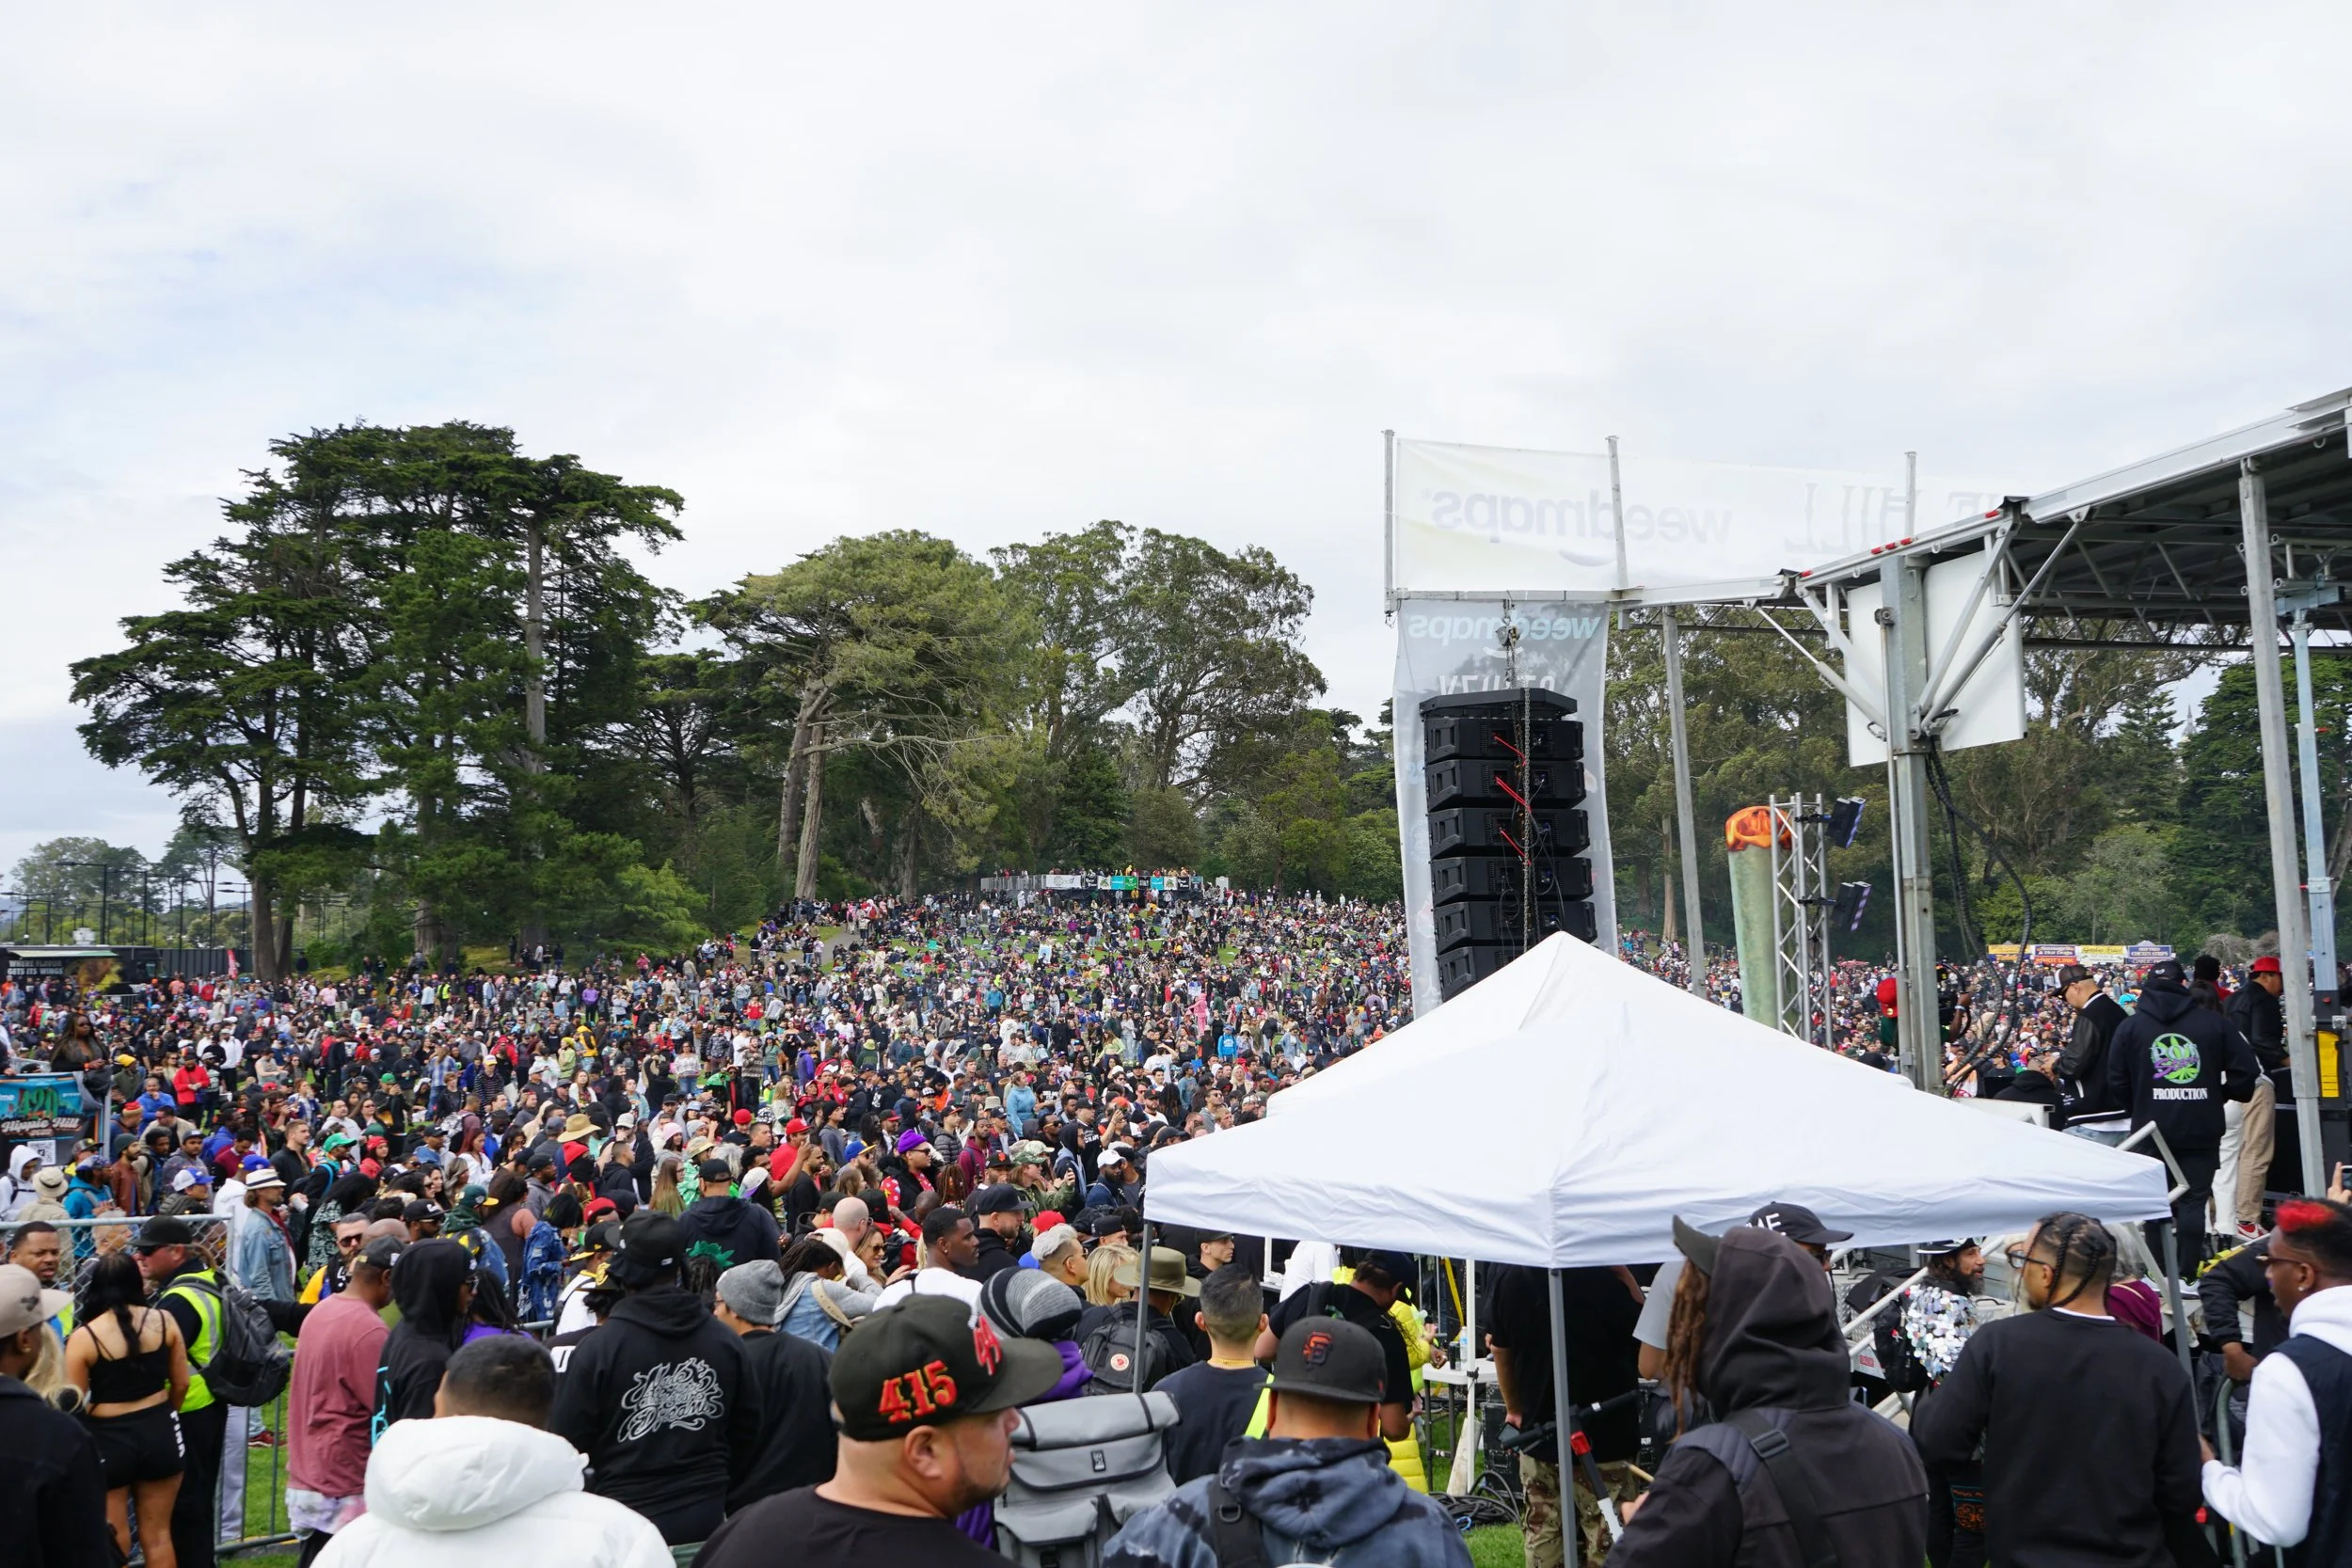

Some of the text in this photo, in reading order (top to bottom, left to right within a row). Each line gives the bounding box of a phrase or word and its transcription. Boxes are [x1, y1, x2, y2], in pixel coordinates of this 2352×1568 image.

[8, 959, 35, 968] WHERE
[7, 967, 25, 975] GETS
[25, 967, 38, 975] ITS
[2153, 1087, 2208, 1101] PRODUCTION
[1, 1117, 81, 1133] Hippie Hill
[879, 1359, 958, 1423] 415
